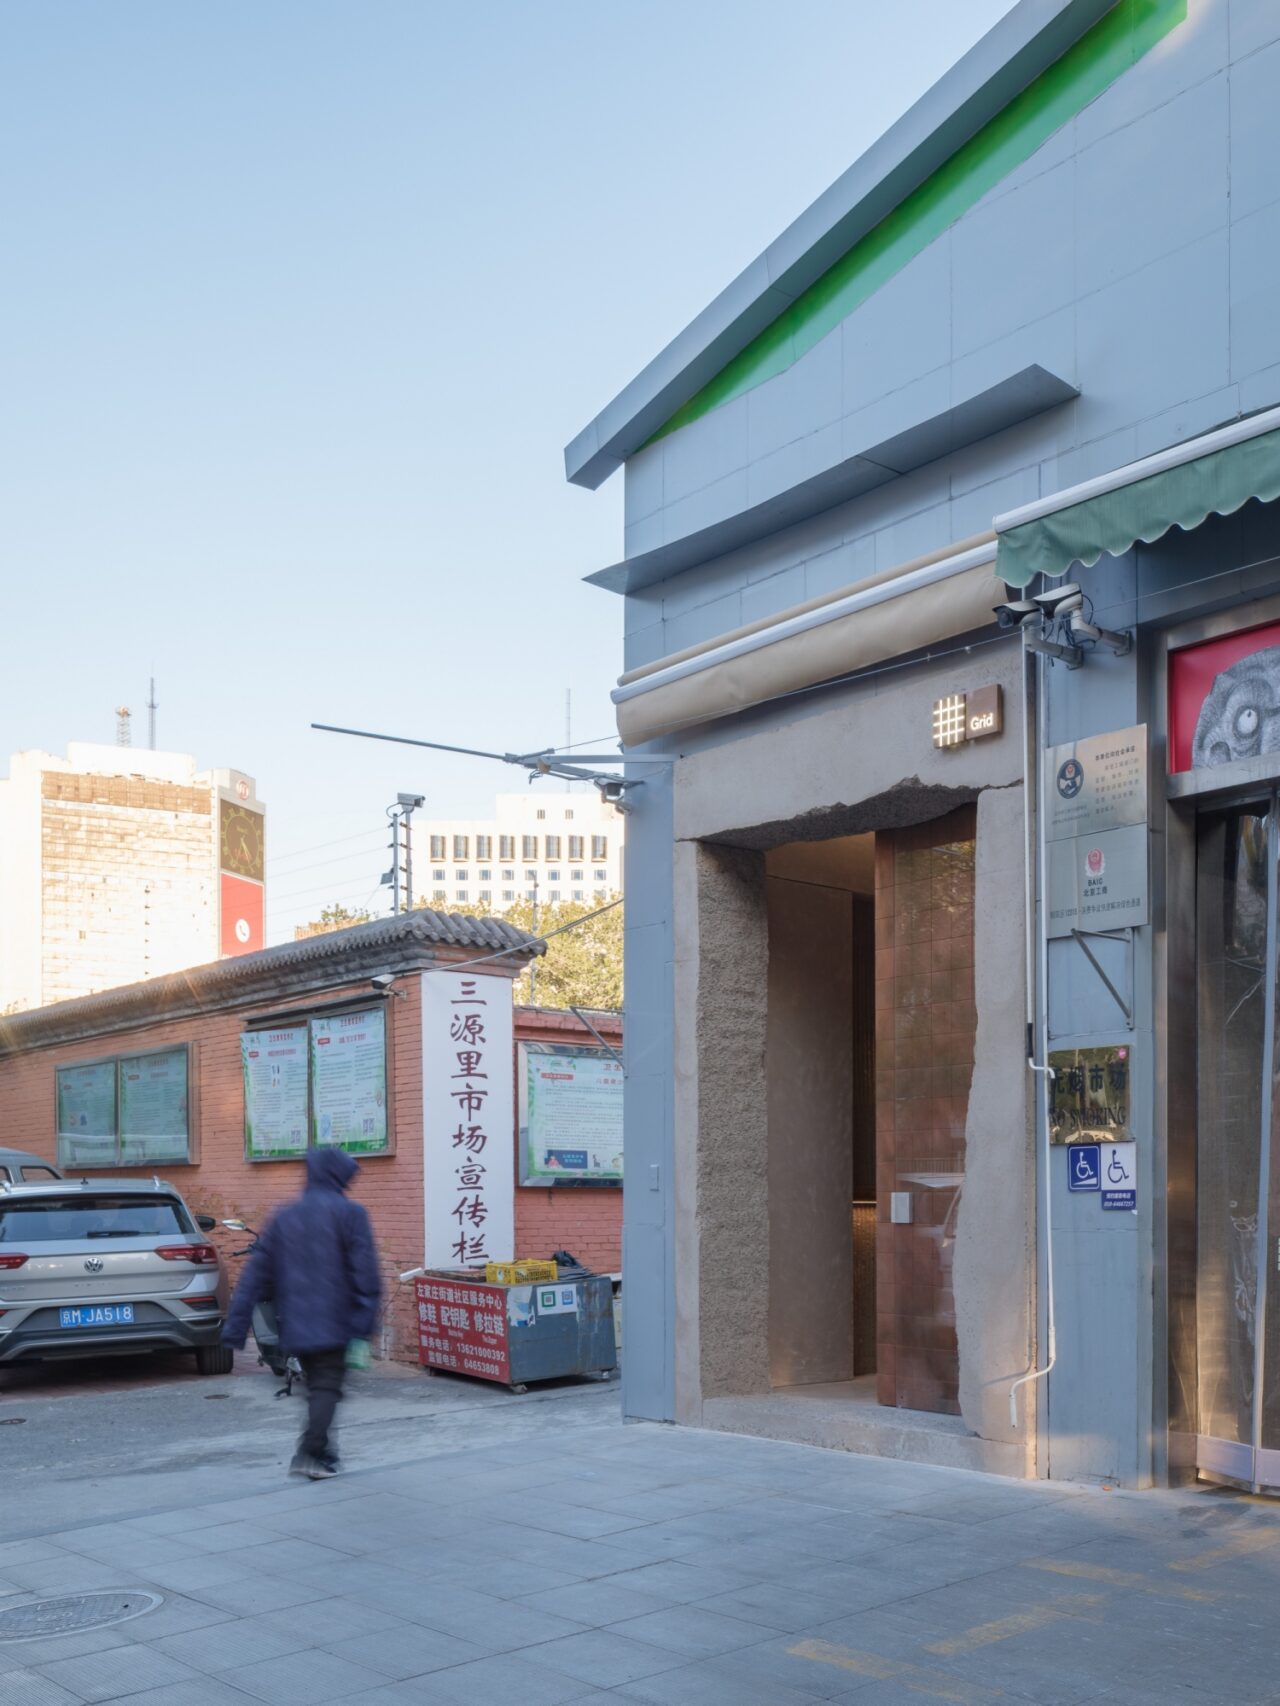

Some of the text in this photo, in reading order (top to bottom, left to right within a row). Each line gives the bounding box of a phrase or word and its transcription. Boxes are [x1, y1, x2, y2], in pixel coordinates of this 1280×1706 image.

[970, 712, 994, 731] Grid
[1087, 878, 1103, 887] BAIC
[450, 981, 490, 1264] 三源里市场宣传栏
[1070, 1106, 1126, 1127] SMOKING
[417, 1284, 503, 1310] 左家庄街道社区服务中心
[419, 1301, 504, 1337] 修鞋 配钥匙 修拉链
